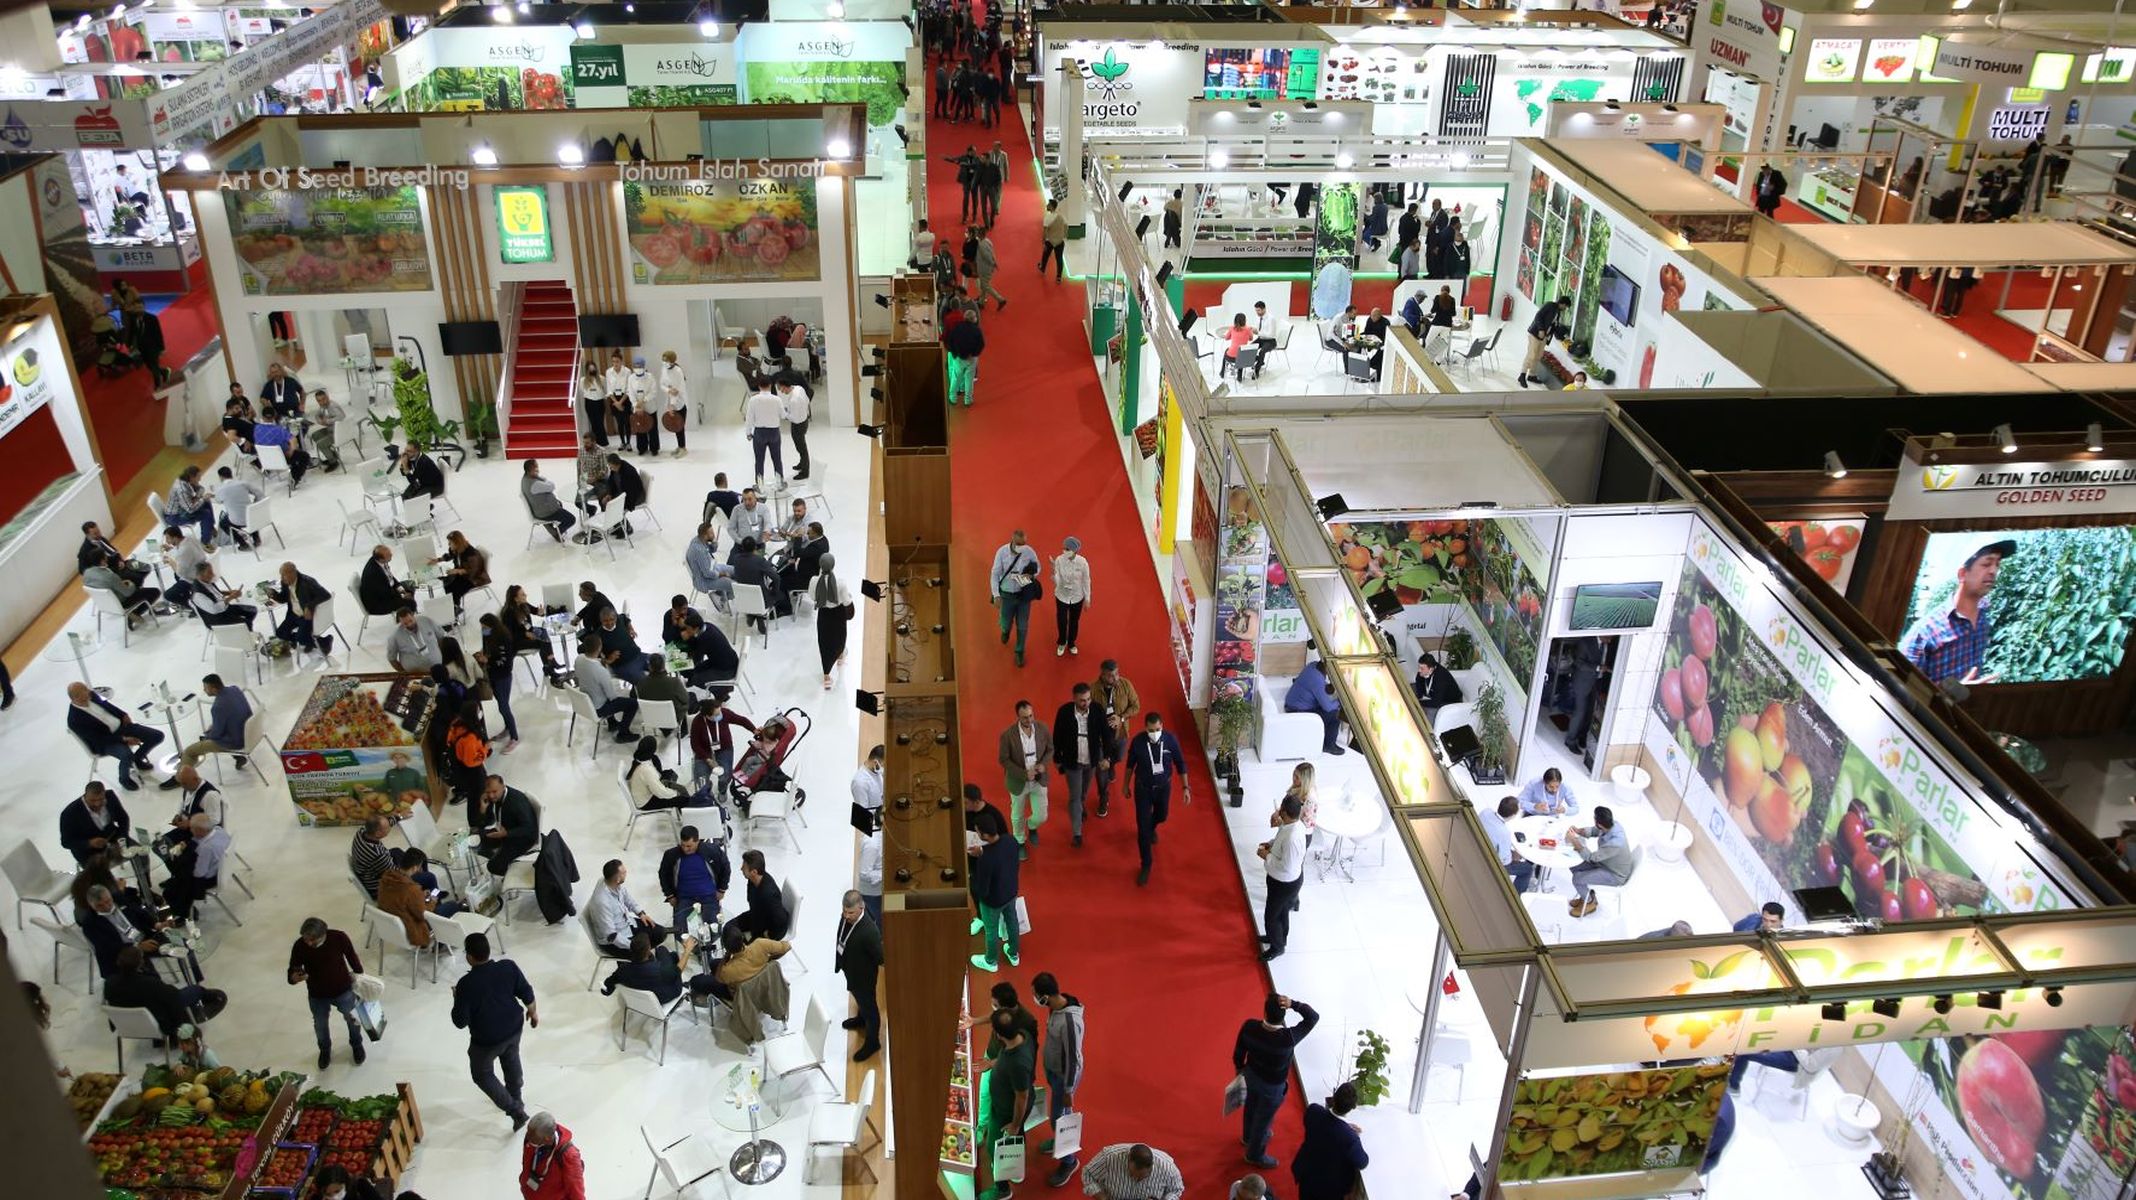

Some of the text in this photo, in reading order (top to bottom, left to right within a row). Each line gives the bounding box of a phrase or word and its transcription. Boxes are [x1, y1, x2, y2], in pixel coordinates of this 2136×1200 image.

[489, 46, 535, 56] ASGEN
[798, 41, 839, 51] ASGEN
[1710, 38, 1747, 67] UZMAN
[577, 64, 619, 80] 27.yıl
[657, 59, 701, 70] ASGEN
[1940, 52, 2024, 76] MULTİ TOHUM
[1993, 106, 2051, 125] MULTİ
[217, 164, 469, 191] Art Of Seed Breeding
[615, 157, 689, 181] Tohum
[699, 157, 748, 180] Islah
[124, 252, 153, 261] BETA
[507, 248, 548, 259] TOHUM
[1974, 469, 2136, 486] ALTIN TOHUMCULU
[1996, 489, 2107, 505] GOLDEN SEED
[1706, 540, 1749, 601] Parlar
[1264, 612, 1302, 633] rlar
[1785, 624, 1840, 696] Parlar
[1901, 747, 1970, 833] Parlar
